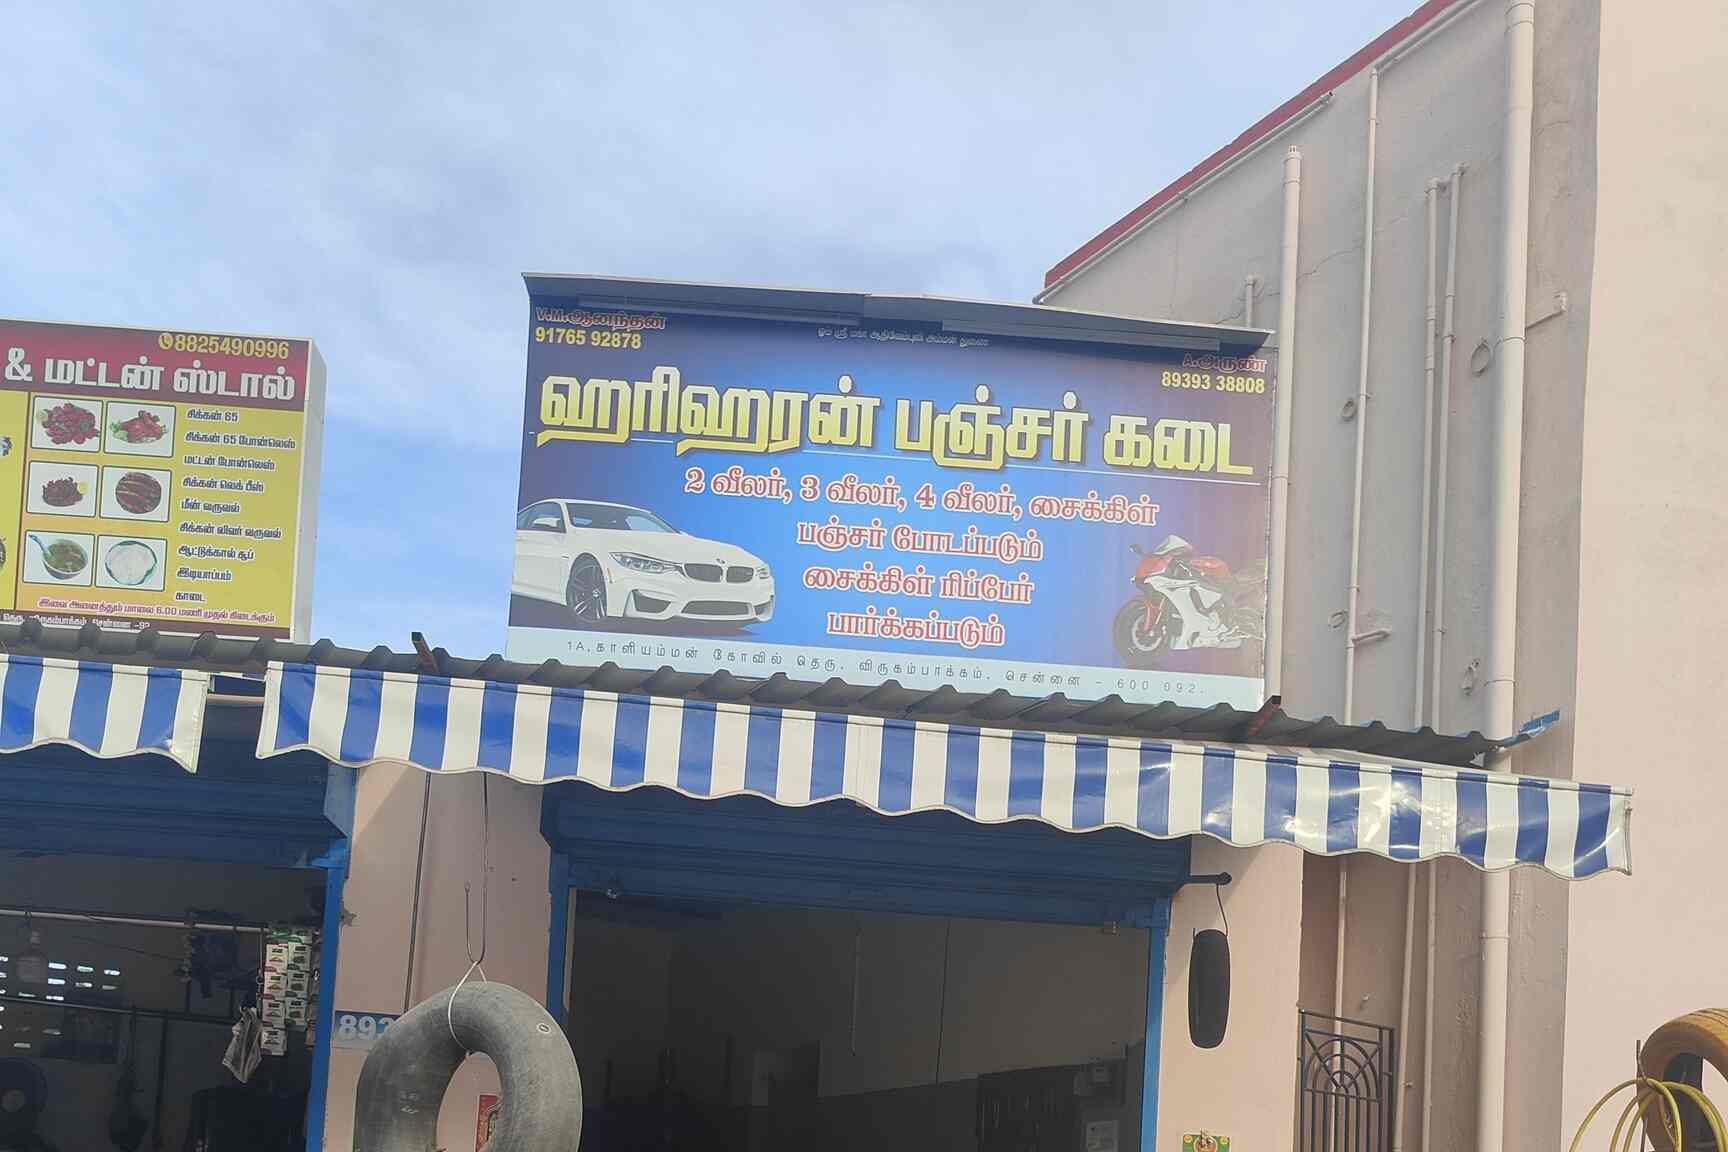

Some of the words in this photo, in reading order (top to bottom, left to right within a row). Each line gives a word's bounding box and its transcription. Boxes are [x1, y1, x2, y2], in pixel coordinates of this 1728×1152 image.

[174, 334, 289, 360] 8825490996
[535, 326, 586, 345] 91765
[591, 331, 642, 350] 92878
[5, 347, 32, 381] &
[44, 356, 165, 391] மட்டன்
[173, 359, 296, 400] ஸ்டால்
[1161, 371, 1211, 390] 89393
[1215, 375, 1265, 394] 38808
[187, 408, 222, 421] சிக்கன்
[224, 411, 238, 422] 65
[536, 365, 881, 458] ஹரிஹரன்
[895, 383, 1089, 471] பஞ்சர்
[1102, 414, 1254, 476] கடை
[185, 431, 220, 443] சிக்கன்
[223, 434, 237, 444] 65
[183, 455, 216, 465] மட்டன்
[685, 465, 705, 493] 2
[711, 465, 793, 504] வீலர்,
[800, 474, 820, 501] 3
[826, 473, 908, 512] வீலர்,
[914, 481, 936, 510] 4
[943, 480, 1023, 520] வீலர்,
[1028, 489, 1160, 527] சைக்கிள்
[797, 515, 887, 551] பஞ்சர்
[892, 524, 1044, 564] போடப்படும்
[803, 561, 934, 597] சைக்கிள்
[939, 568, 1035, 604] ரிப்பேர்
[175, 592, 206, 602] காடை
[156, 606, 178, 617] 6.00
[826, 605, 1006, 649] பார்க்கப்படும்
[712, 648, 783, 666] கோவில்
[1005, 669, 1081, 688] சென்னை
[1117, 678, 1150, 691] 600
